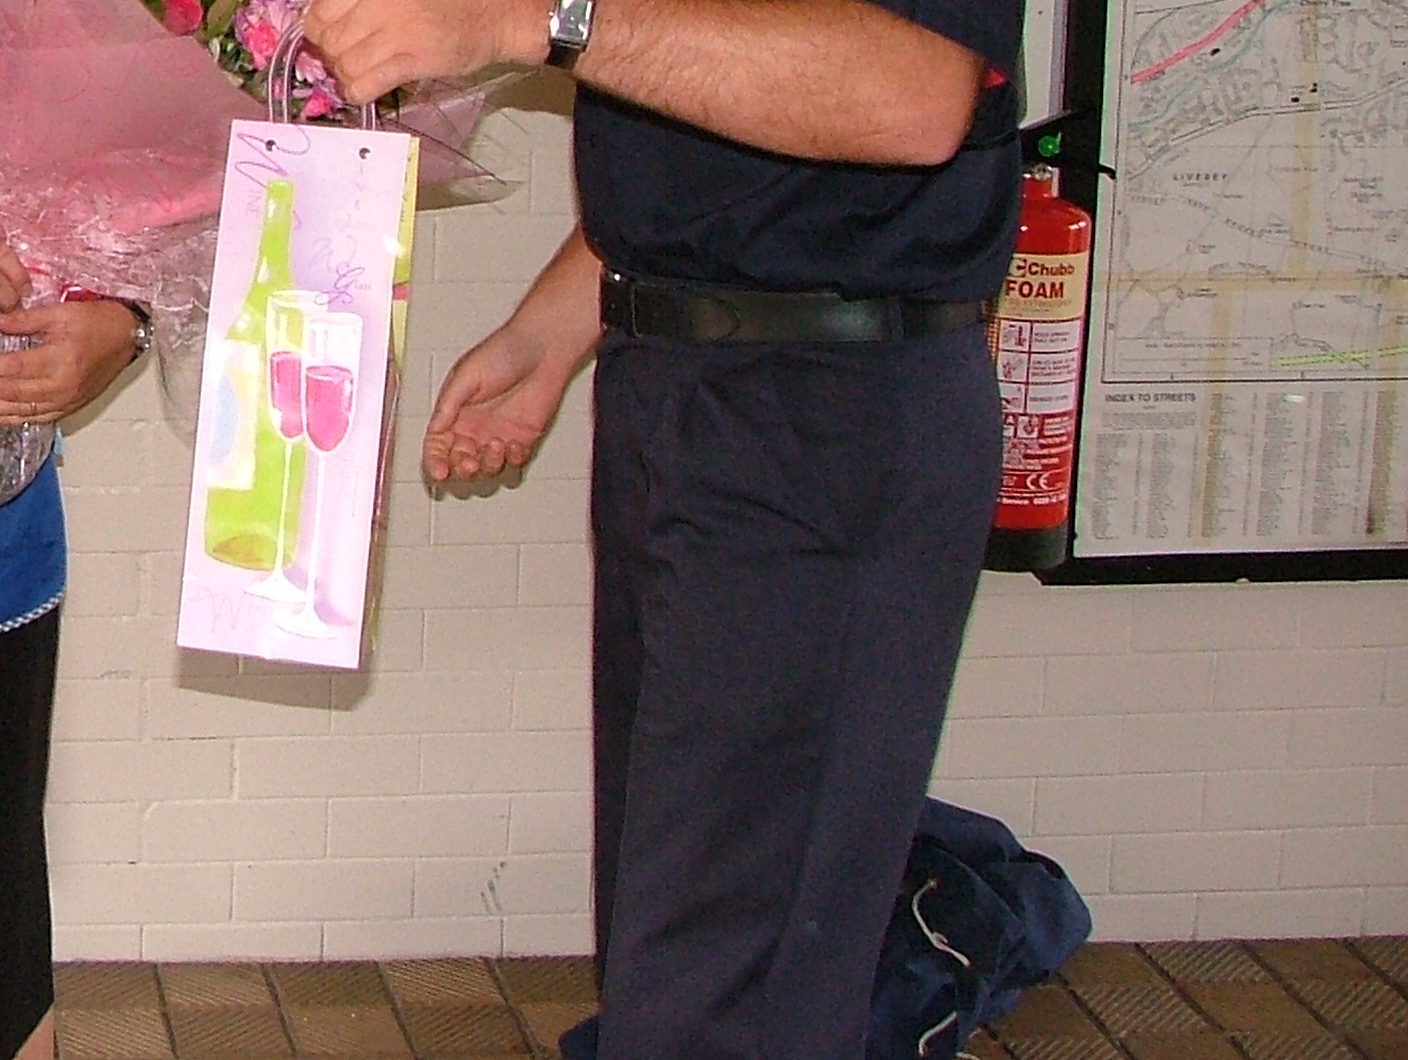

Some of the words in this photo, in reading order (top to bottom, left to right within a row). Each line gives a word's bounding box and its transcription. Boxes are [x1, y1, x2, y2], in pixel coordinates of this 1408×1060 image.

[1028, 261, 1075, 276] Chubb
[1005, 280, 1065, 299] FOAM
[1104, 393, 1135, 402] INDEX
[1138, 393, 1151, 402] TO
[1153, 392, 1196, 402] STREETS
